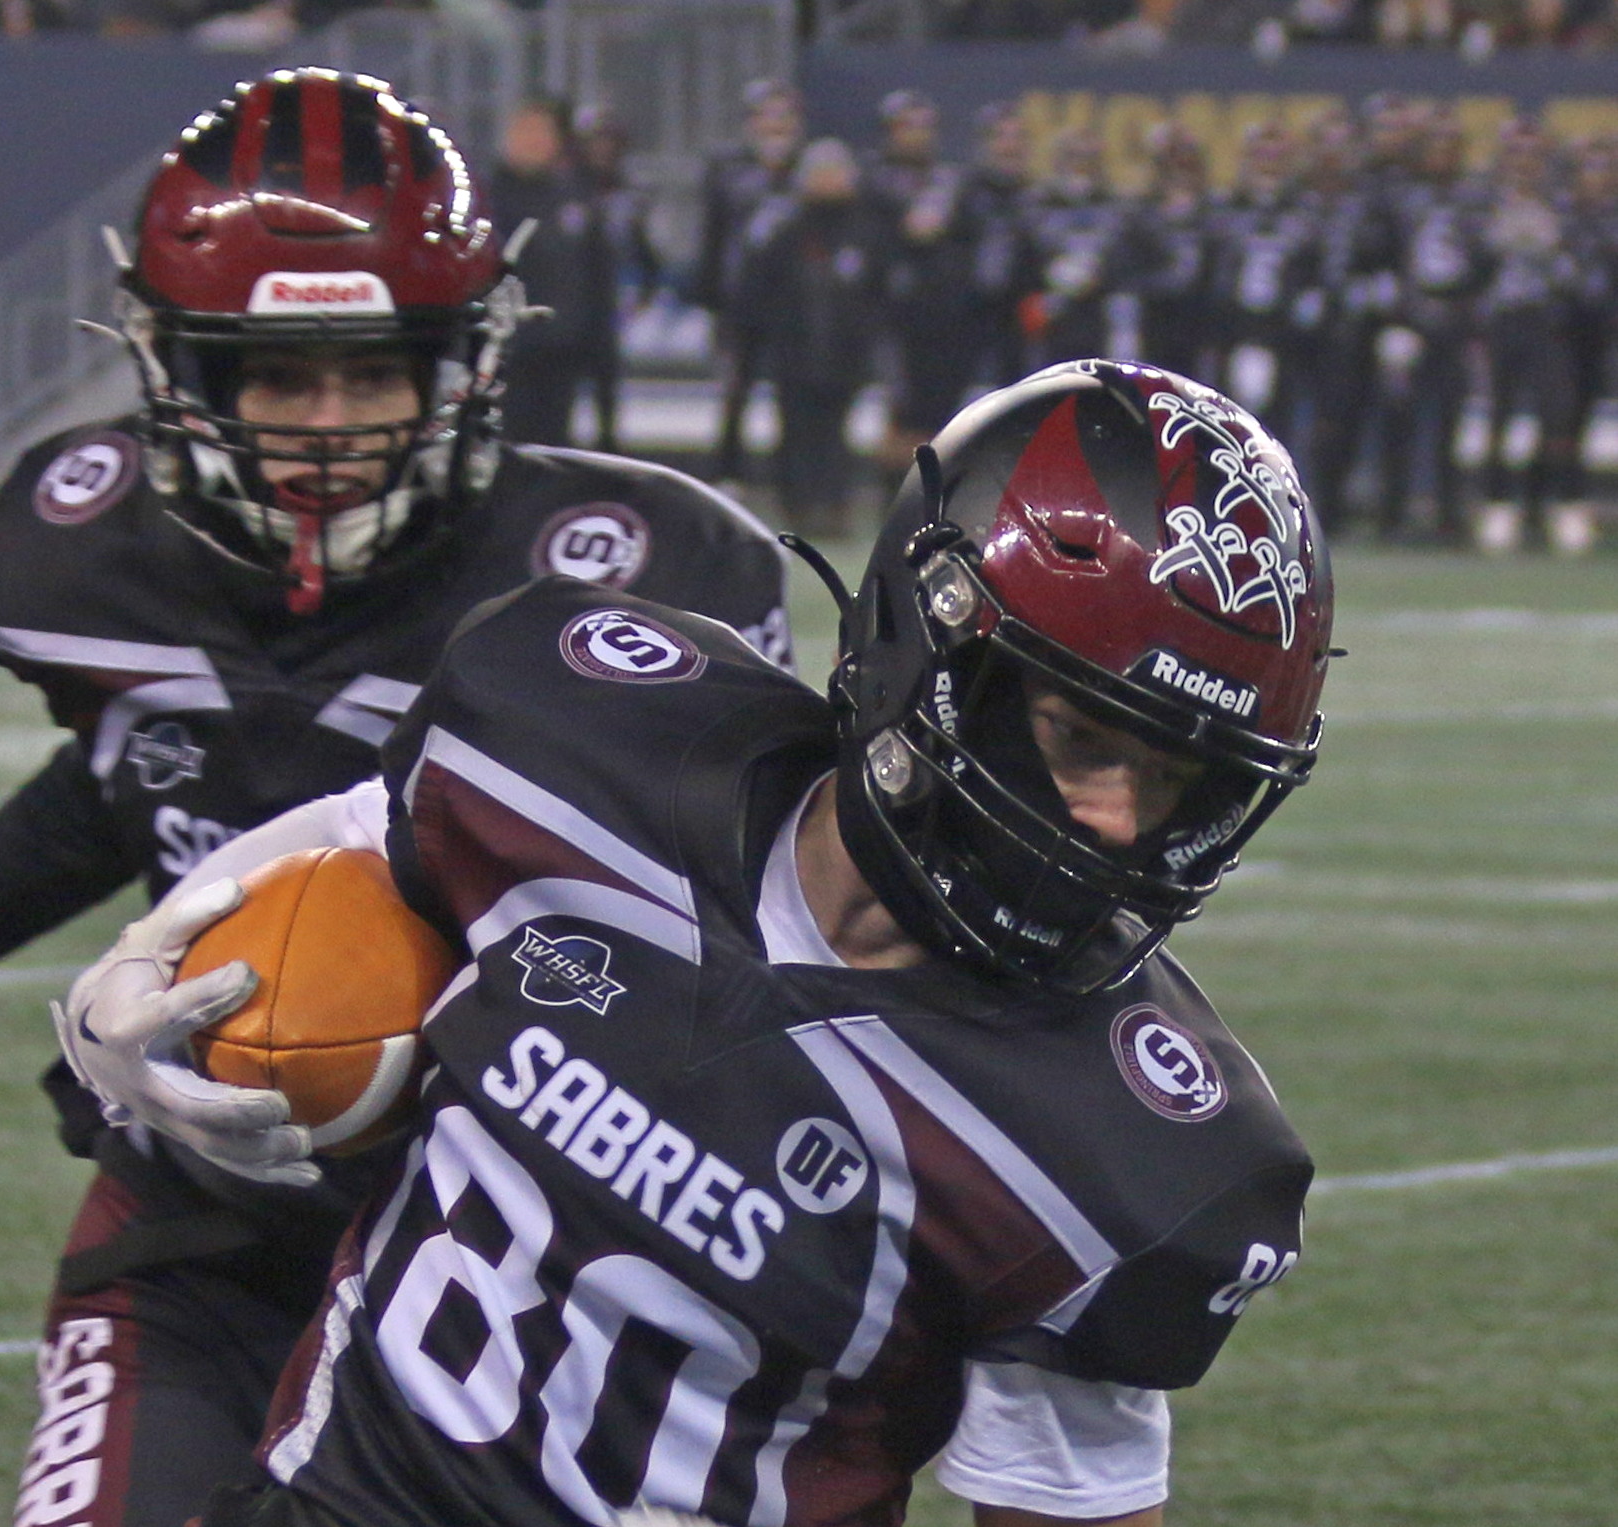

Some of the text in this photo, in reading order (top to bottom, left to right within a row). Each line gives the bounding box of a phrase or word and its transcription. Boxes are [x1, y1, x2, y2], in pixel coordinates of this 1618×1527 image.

[271, 280, 374, 303] Riddell
[601, 624, 669, 669] S
[1152, 651, 1257, 717] Riddell
[524, 937, 610, 1000] WHSFL
[1145, 1028, 1200, 1090] S
[482, 1025, 784, 1282] SABRES
[785, 1124, 861, 1200] DF
